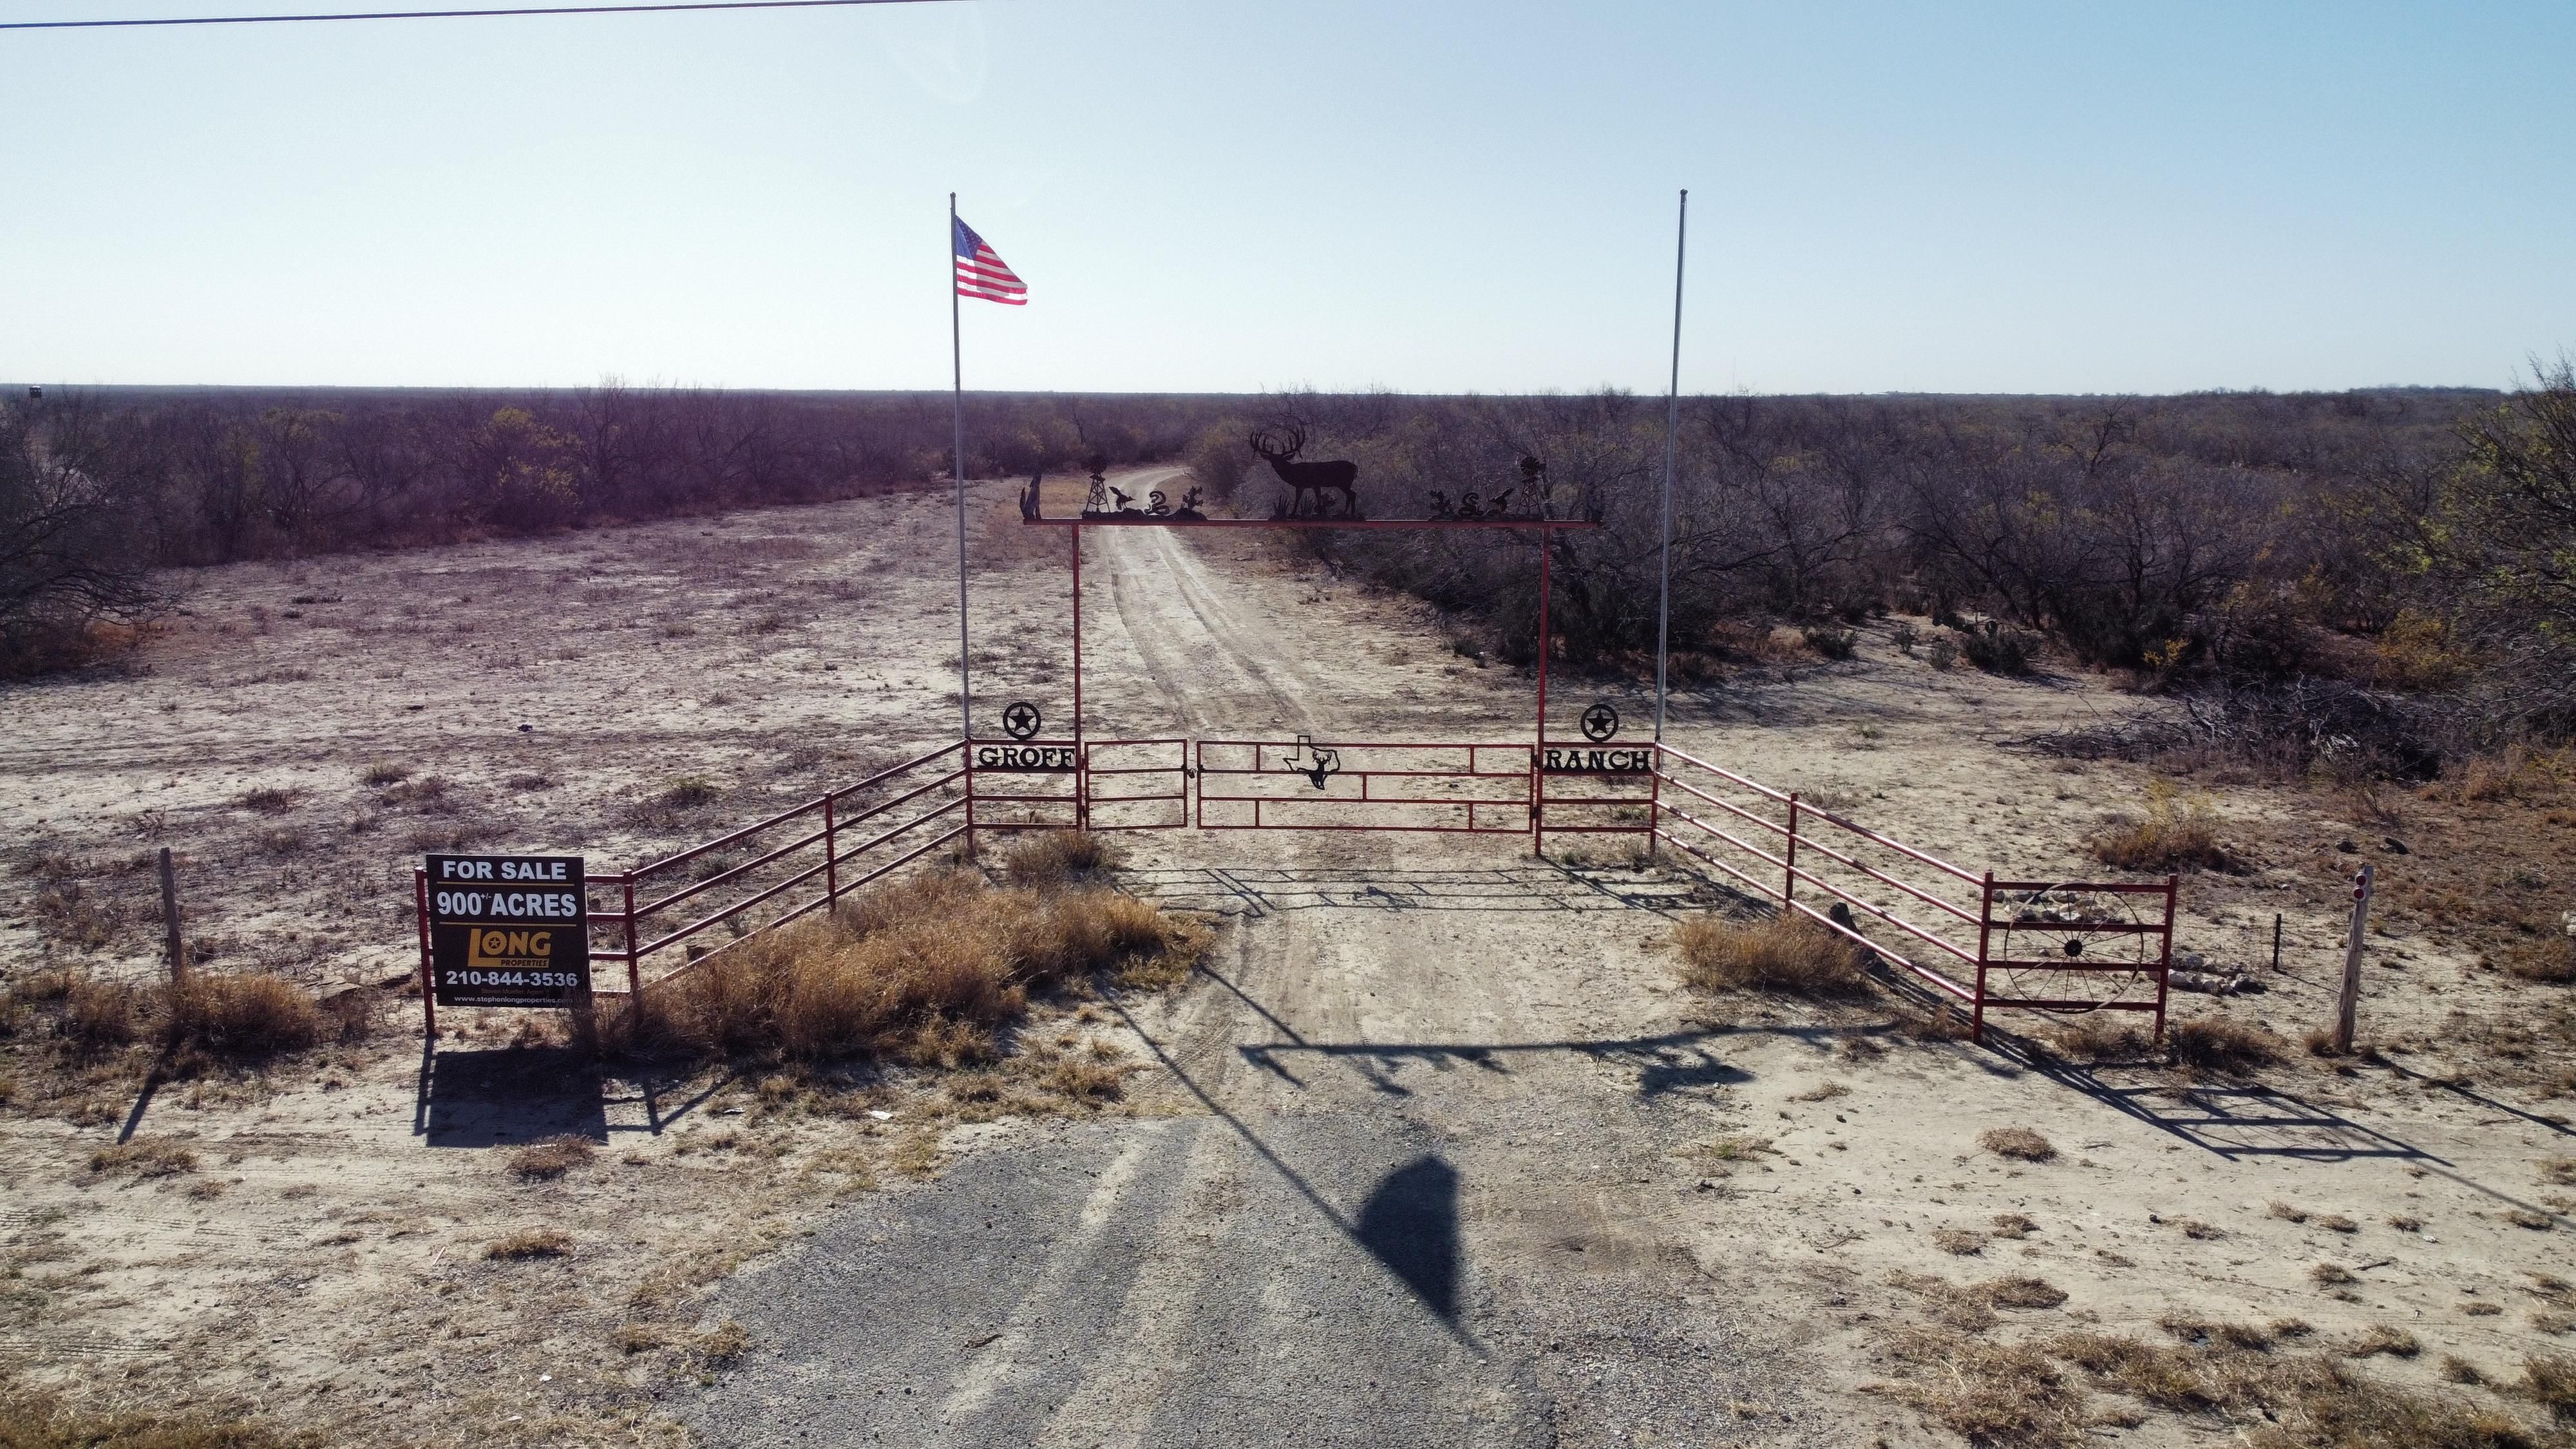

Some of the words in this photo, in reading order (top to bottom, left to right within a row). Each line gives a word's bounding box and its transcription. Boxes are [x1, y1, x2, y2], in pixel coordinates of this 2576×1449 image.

[978, 747, 1075, 769] GROFF
[1544, 750, 1653, 772] RANCH
[442, 860, 494, 879] FOR
[501, 862, 567, 880] SALE
[489, 893, 577, 916] ACRES
[468, 928, 552, 967] LONG
[446, 971, 578, 987] 210-844-3536
